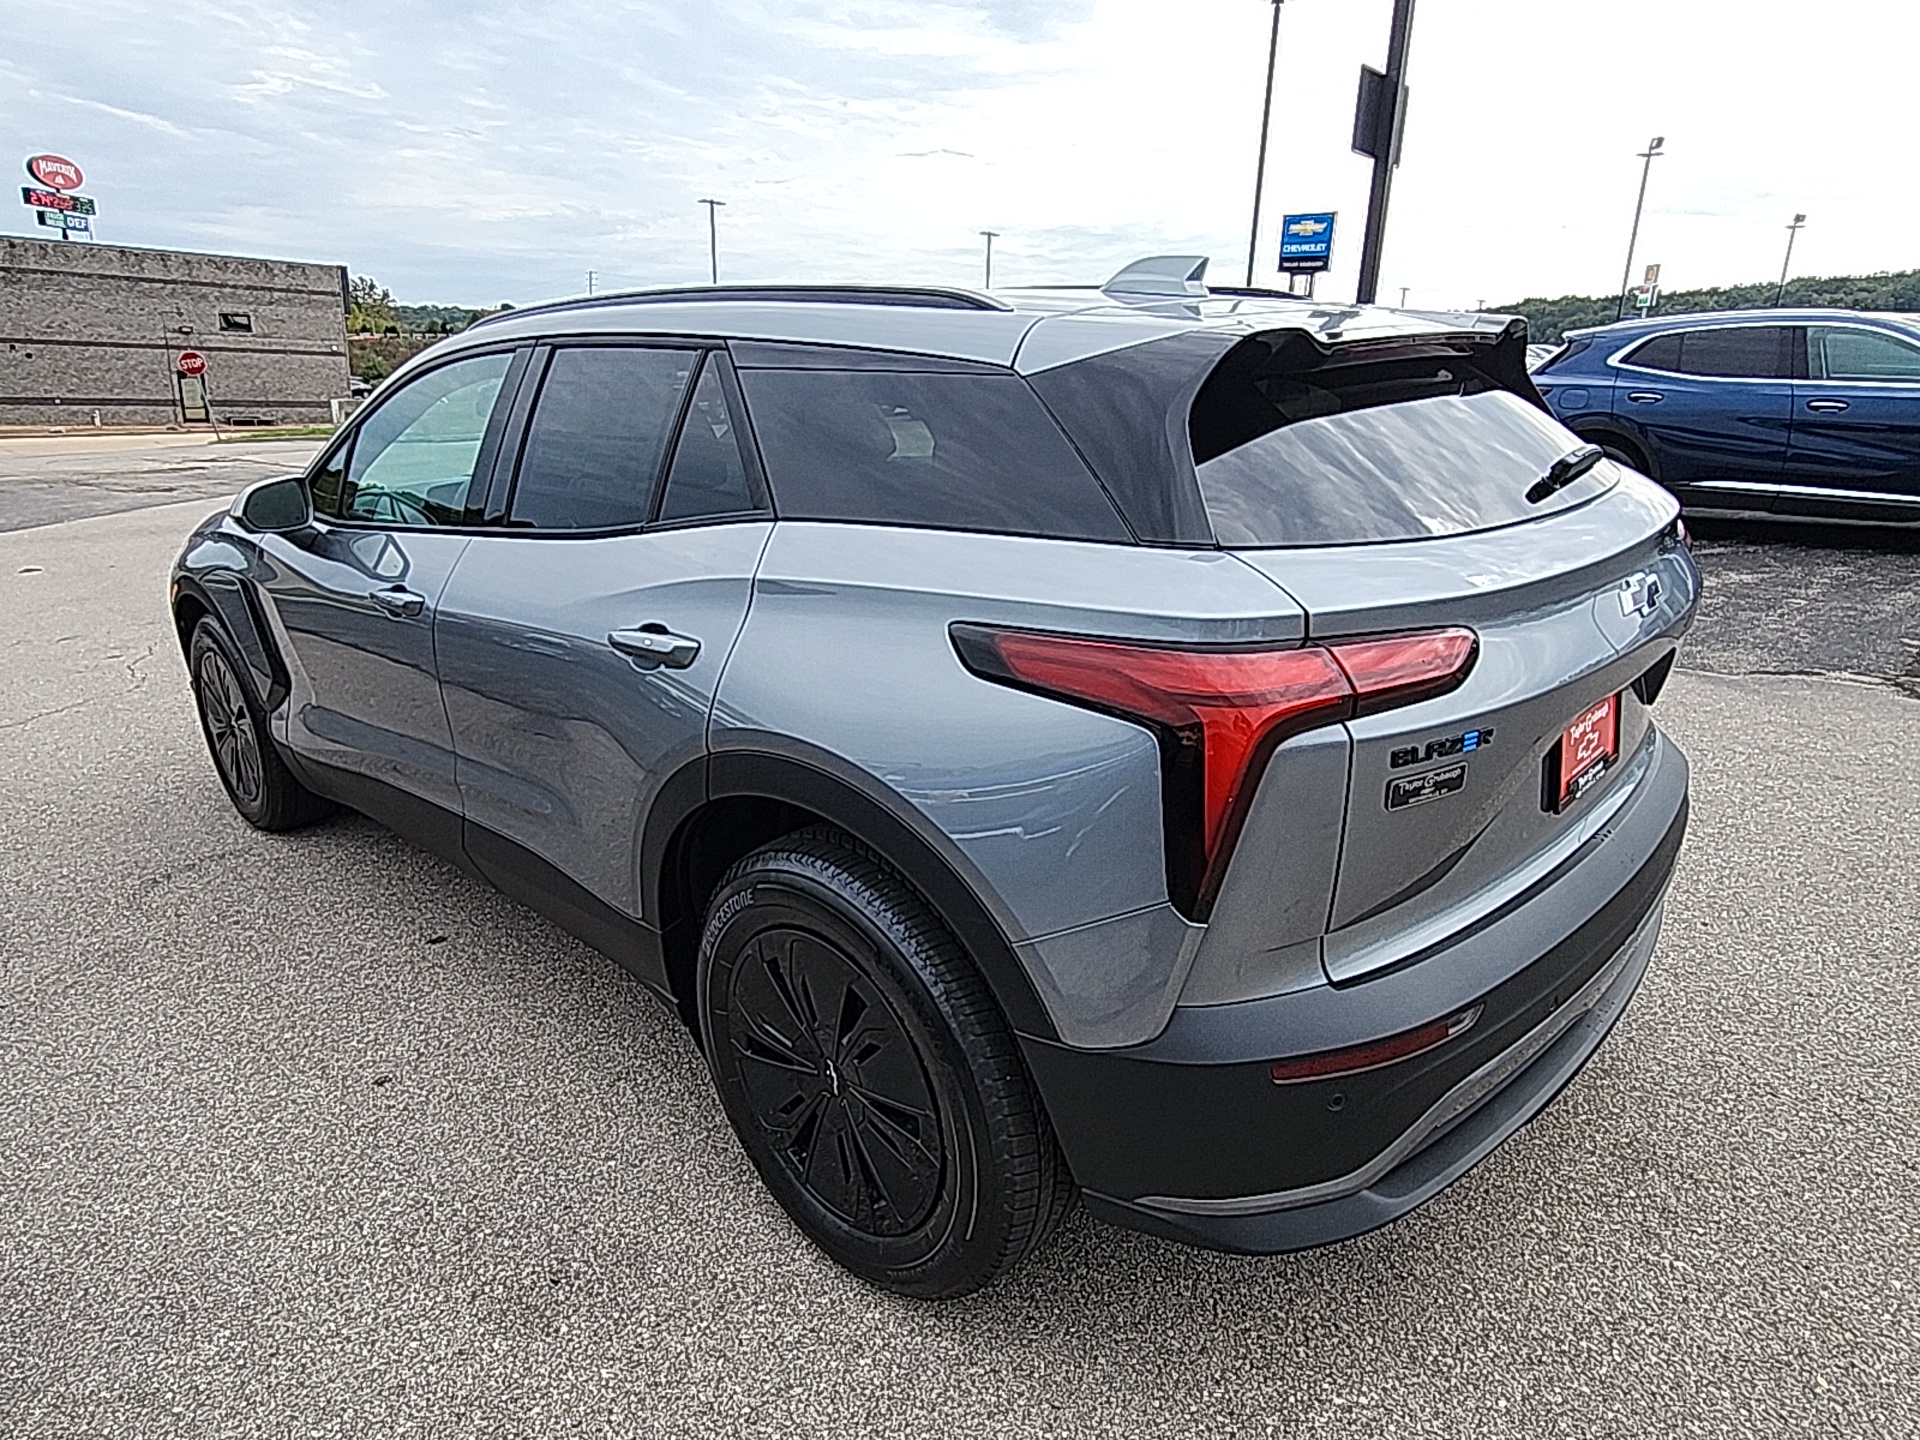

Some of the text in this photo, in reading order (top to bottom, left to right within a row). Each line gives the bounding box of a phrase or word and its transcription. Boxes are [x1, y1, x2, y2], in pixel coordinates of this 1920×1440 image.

[66, 216, 87, 229] DEF
[1283, 243, 1328, 252] CHEVROLET
[181, 357, 203, 370] STOP
[1390, 728, 1495, 769] BLAZER
[702, 889, 755, 957] BRIDGESTONE
